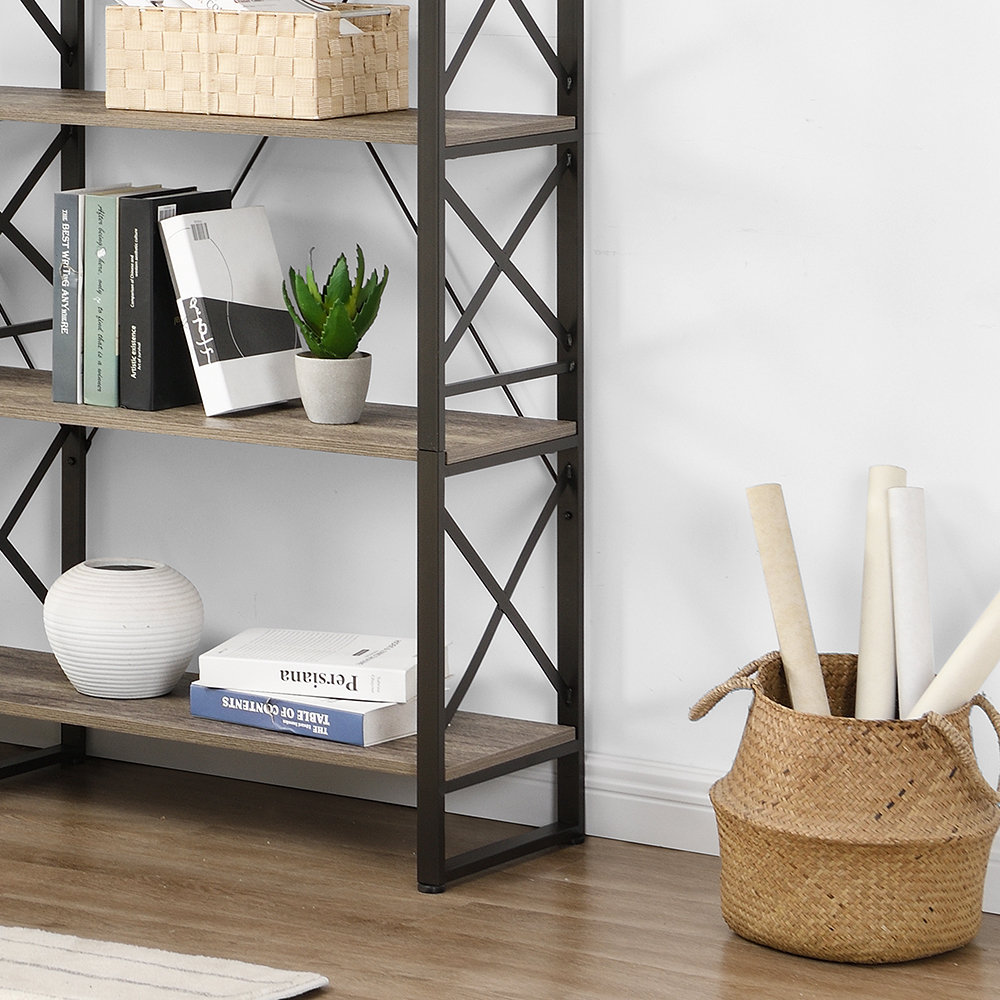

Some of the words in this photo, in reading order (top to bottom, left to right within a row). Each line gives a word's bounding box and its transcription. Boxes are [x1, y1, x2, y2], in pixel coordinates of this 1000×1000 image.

[96, 204, 106, 225] After
[61, 223, 70, 248] BEST
[280, 669, 358, 692] Persiana
[221, 696, 279, 716] CONTENTS
[280, 706, 295, 719] OF
[296, 709, 330, 726] TABLE
[312, 725, 328, 736] THE
